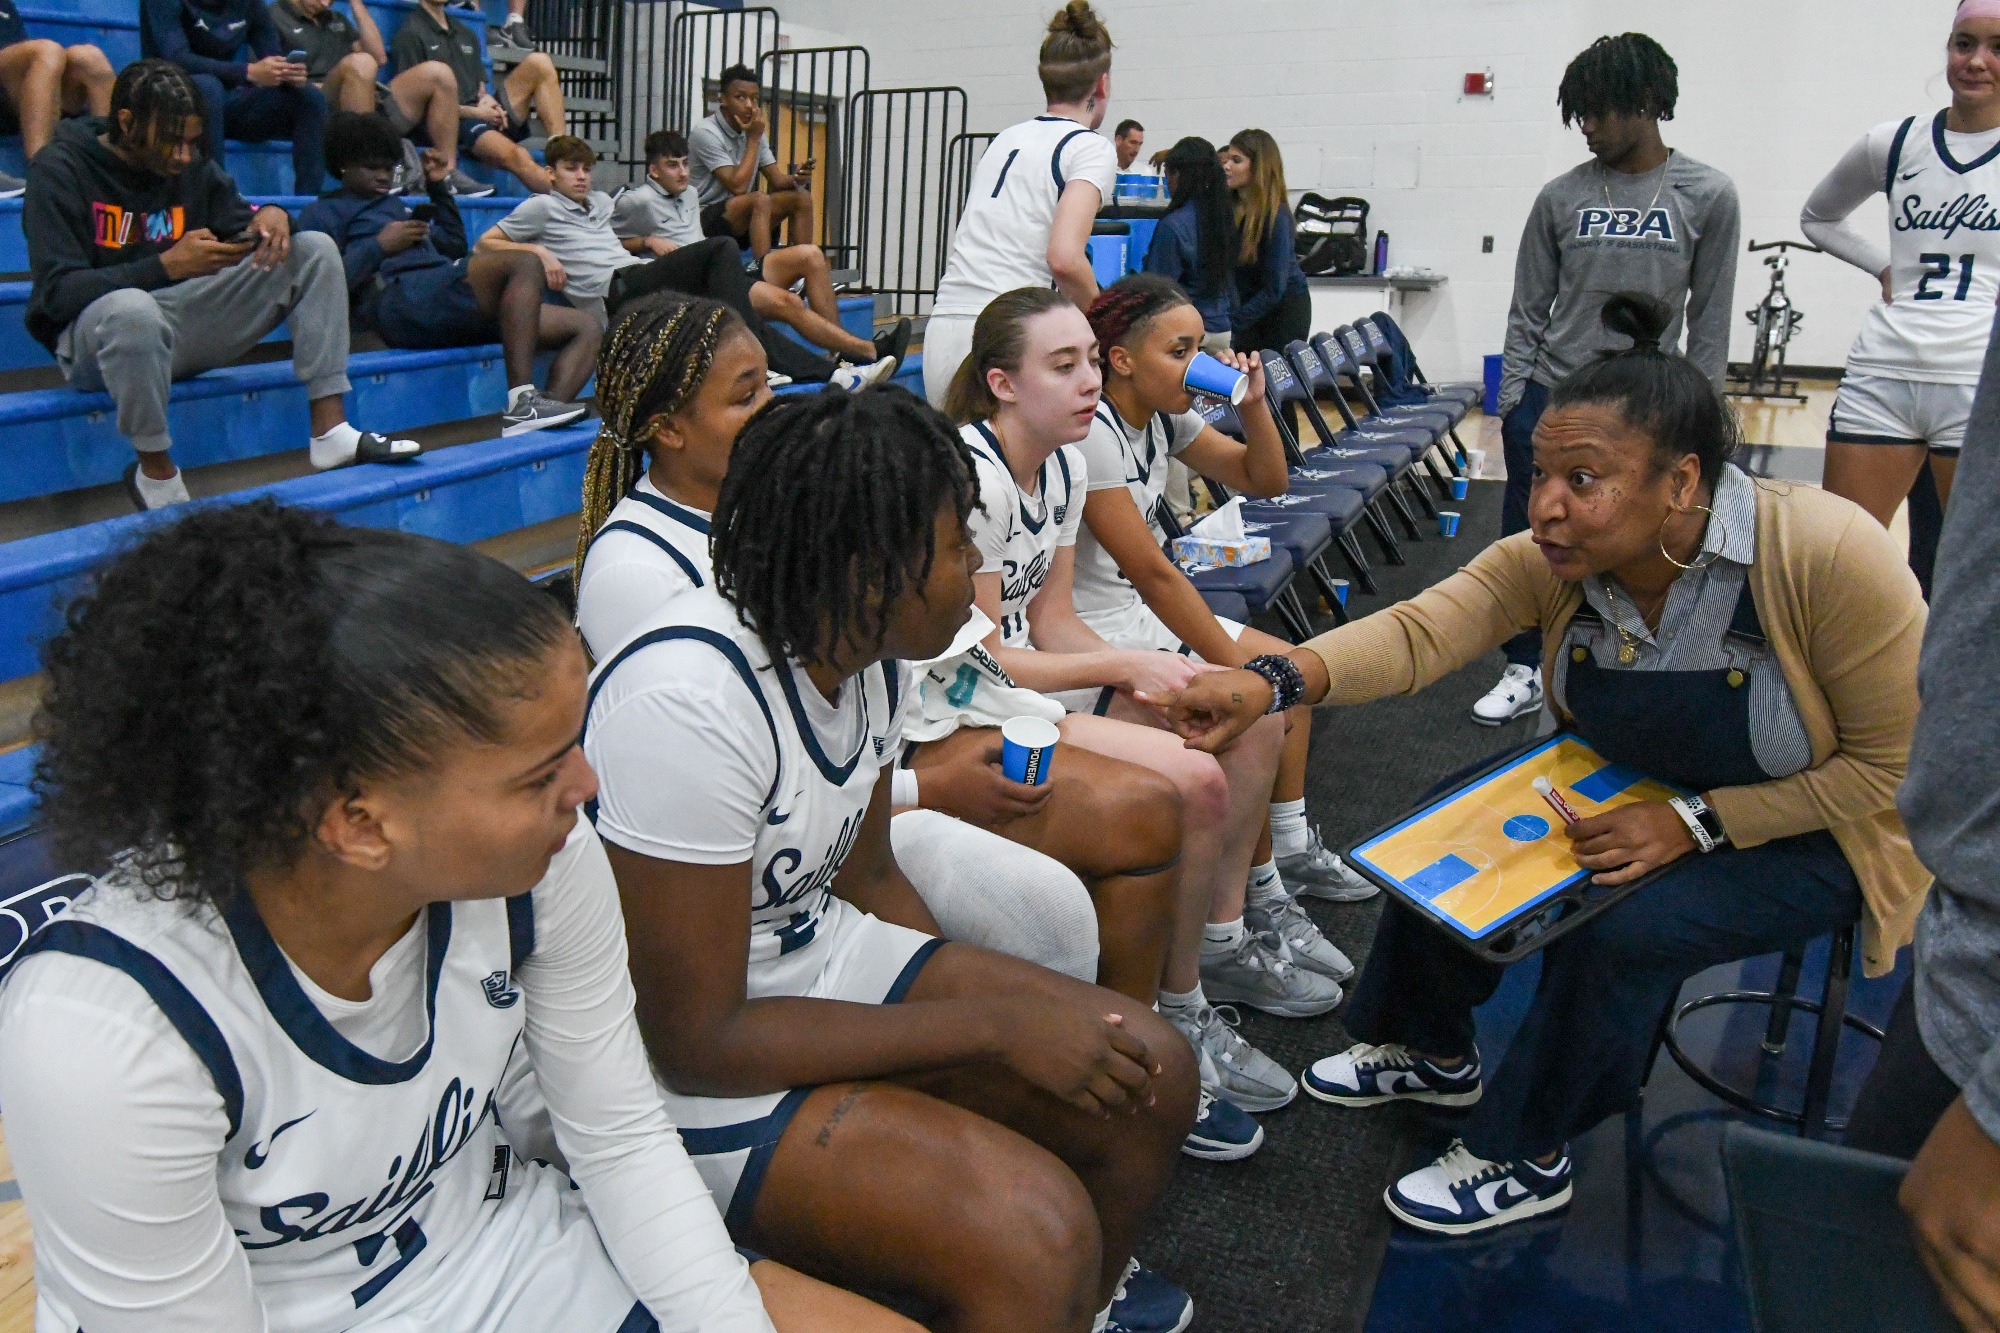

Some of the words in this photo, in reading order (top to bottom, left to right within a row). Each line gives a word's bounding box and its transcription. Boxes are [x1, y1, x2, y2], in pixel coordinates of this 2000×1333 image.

[990, 148, 1021, 199] 1
[1574, 207, 1677, 242] PBA
[1894, 192, 2000, 240] Sailfis
[1913, 252, 1975, 301] 21
[1001, 549, 1051, 606] Sailfi
[234, 1027, 524, 1250] Sailfi
